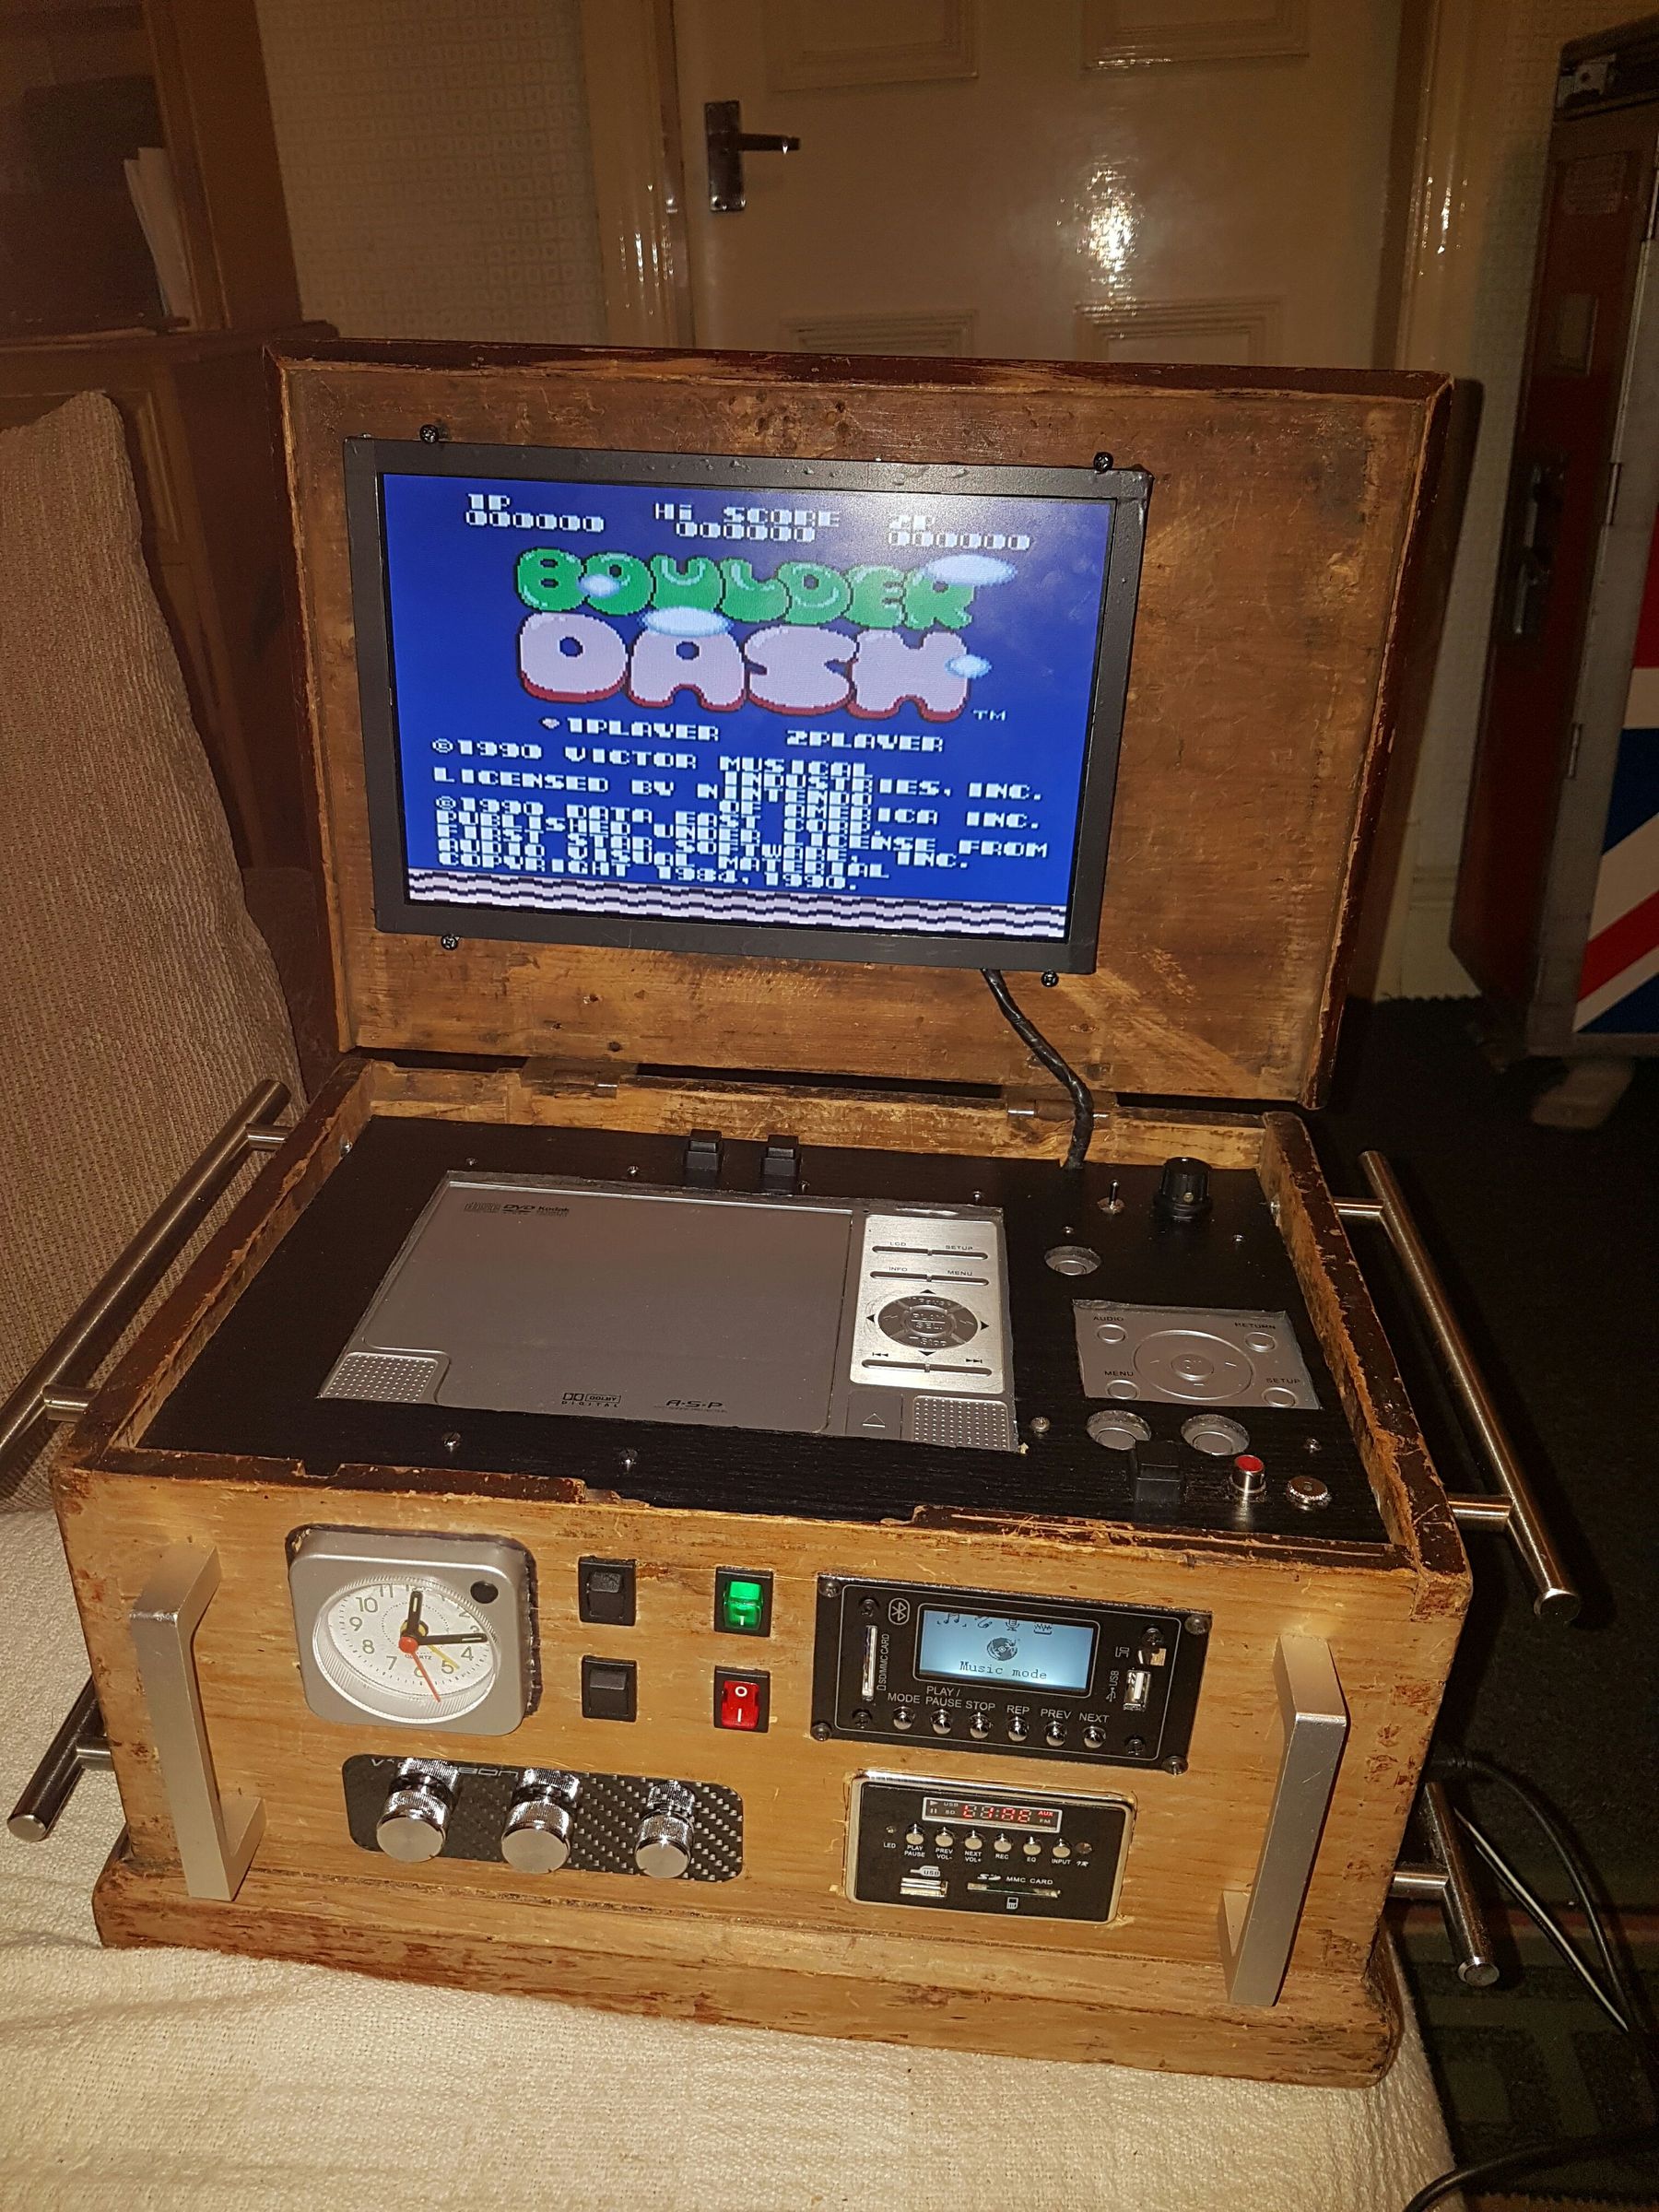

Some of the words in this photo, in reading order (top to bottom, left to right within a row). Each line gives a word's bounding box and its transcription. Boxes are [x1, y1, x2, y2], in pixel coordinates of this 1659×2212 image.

[468, 493, 510, 511] 1P
[465, 510, 605, 533] 000000
[723, 506, 840, 528] SCORE
[676, 521, 816, 543] 000000
[888, 530, 1031, 551] 000000
[516, 547, 976, 630] BOULDER
[517, 611, 971, 723] DASH
[972, 709, 1006, 722] TM
[567, 716, 719, 741] 1PLAYER
[786, 729, 945, 753] 2PLAYER
[564, 746, 697, 770] VICTOR
[719, 755, 871, 780] MUSICAL
[969, 782, 1042, 802] INC.
[432, 766, 609, 794] LICENSED
[630, 779, 674, 797] BY
[718, 799, 762, 816] OF
[966, 811, 1039, 830] INC.
[566, 804, 653, 823] DATA
[674, 809, 761, 830] EAST
[435, 809, 631, 836] PUBLISHED
[653, 822, 761, 845] UNDER
[783, 830, 937, 853] LICENSE
[958, 839, 1048, 858] FROM
[437, 824, 544, 844] FIRST
[567, 832, 653, 852] STAR
[896, 850, 969, 869] INC.
[438, 838, 546, 859] AUDIO
[567, 845, 695, 869] VISUAL
[718, 855, 890, 879] MATERIAL
[438, 850, 631, 877] COPYRIGHT
[560, 1400, 619, 1408] DIGITAL
[356, 1596, 379, 1613] 10
[349, 1617, 363, 1631] 9
[362, 1639, 375, 1654] 8
[461, 1645, 474, 1661] 4
[879, 1633, 890, 1655] CARD
[386, 1655, 398, 1670] 7
[441, 1660, 454, 1675] 5
[959, 1660, 1004, 1676] Music
[1012, 1669, 1048, 1680] mode
[1109, 1670, 1120, 1687] USB
[888, 1692, 921, 1704] MODE
[926, 1685, 954, 1697] PLAY
[925, 1696, 962, 1709] PAUSE
[965, 1700, 995, 1712] STOP
[1006, 1705, 1030, 1715] REP
[1041, 1708, 1072, 1720] PREV
[1079, 1712, 1110, 1724] NEXT
[904, 1850, 925, 1858] PAUSE
